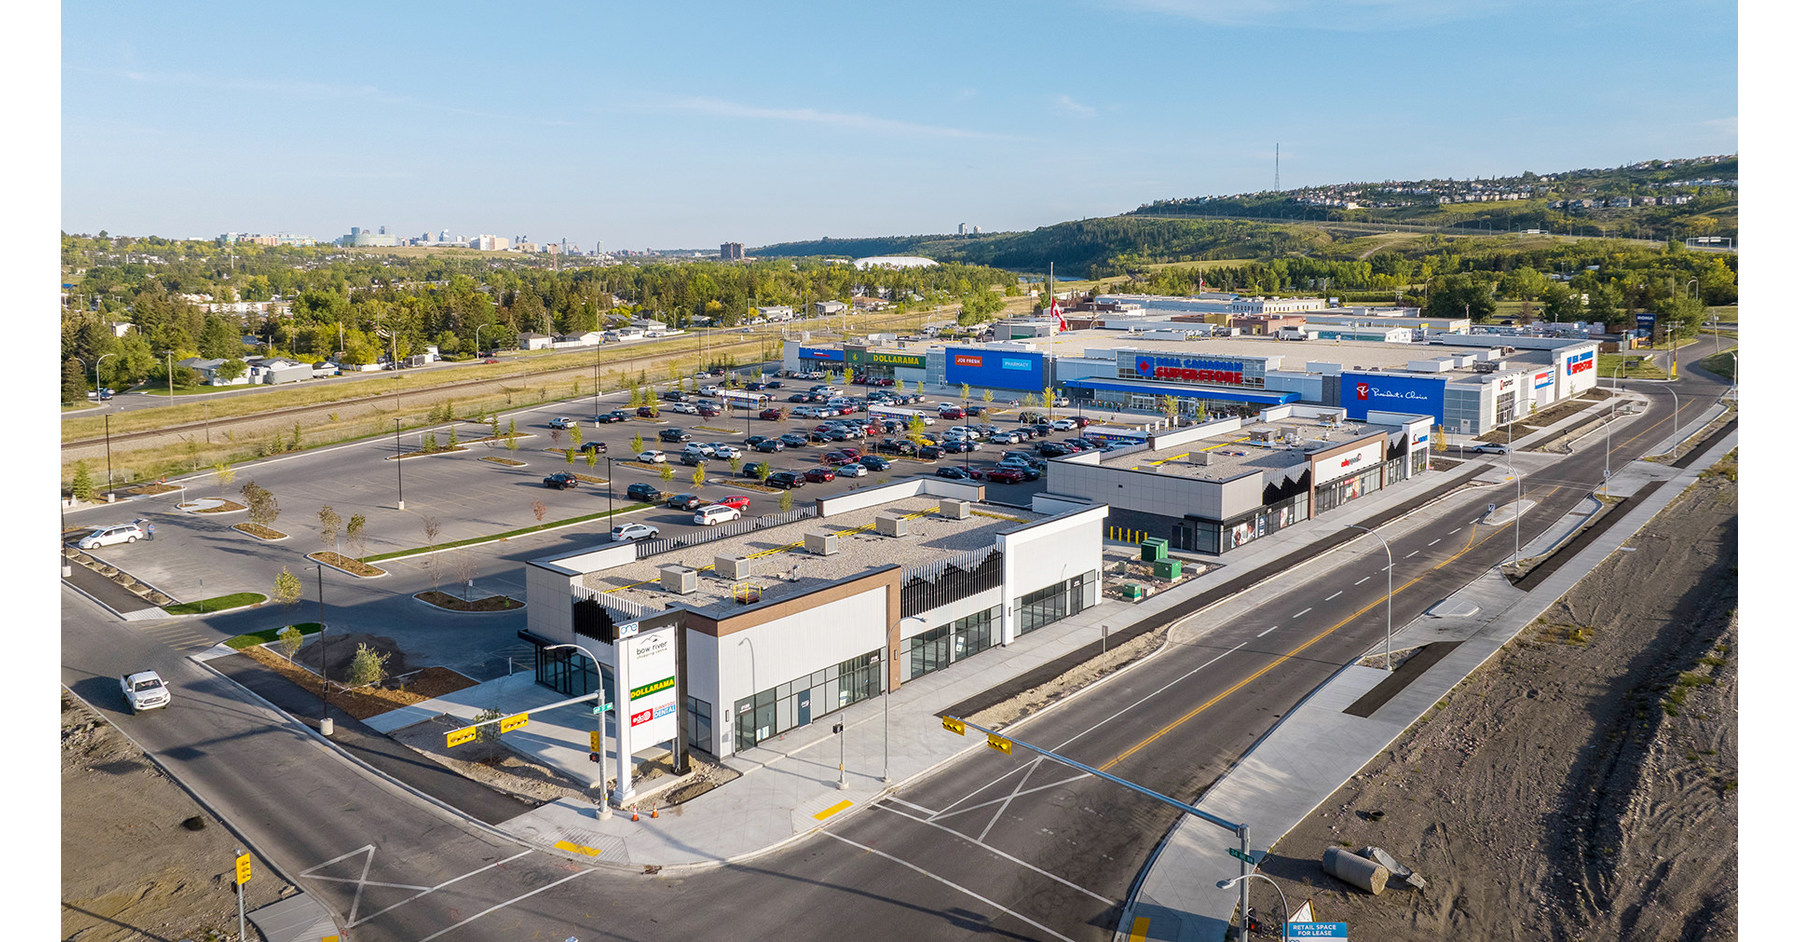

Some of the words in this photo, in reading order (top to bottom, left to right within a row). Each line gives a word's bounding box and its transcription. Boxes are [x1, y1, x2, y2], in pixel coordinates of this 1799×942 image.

[873, 354, 919, 365] DOLLARAMA
[1183, 359, 1243, 371] CANADIAN
[1155, 366, 1243, 384] SUPERSTORE
[620, 623, 638, 635] one
[636, 646, 651, 655] bow
[652, 641, 667, 650] river
[630, 678, 675, 699] DOLLARAMA
